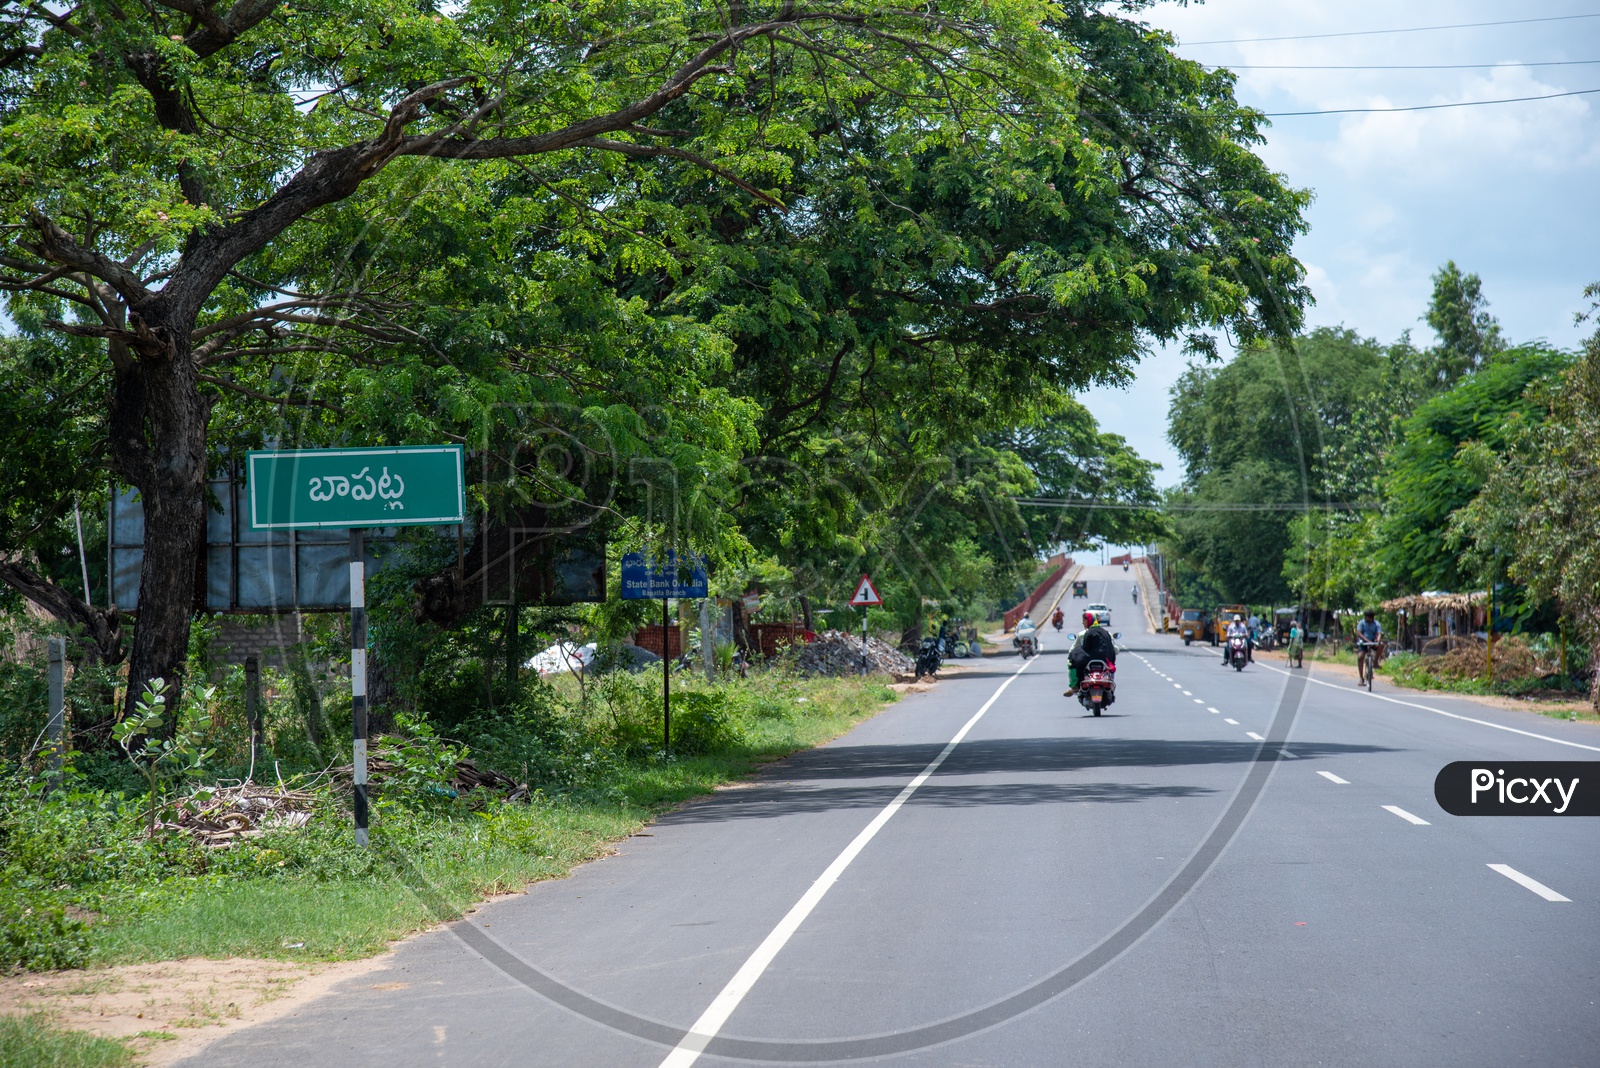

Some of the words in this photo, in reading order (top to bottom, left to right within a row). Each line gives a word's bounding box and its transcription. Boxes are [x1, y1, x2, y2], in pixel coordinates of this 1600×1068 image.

[309, 466, 405, 510] బాపట్ల
[626, 580, 648, 588] State
[649, 579, 670, 588] Bank
[683, 579, 703, 587] Idia
